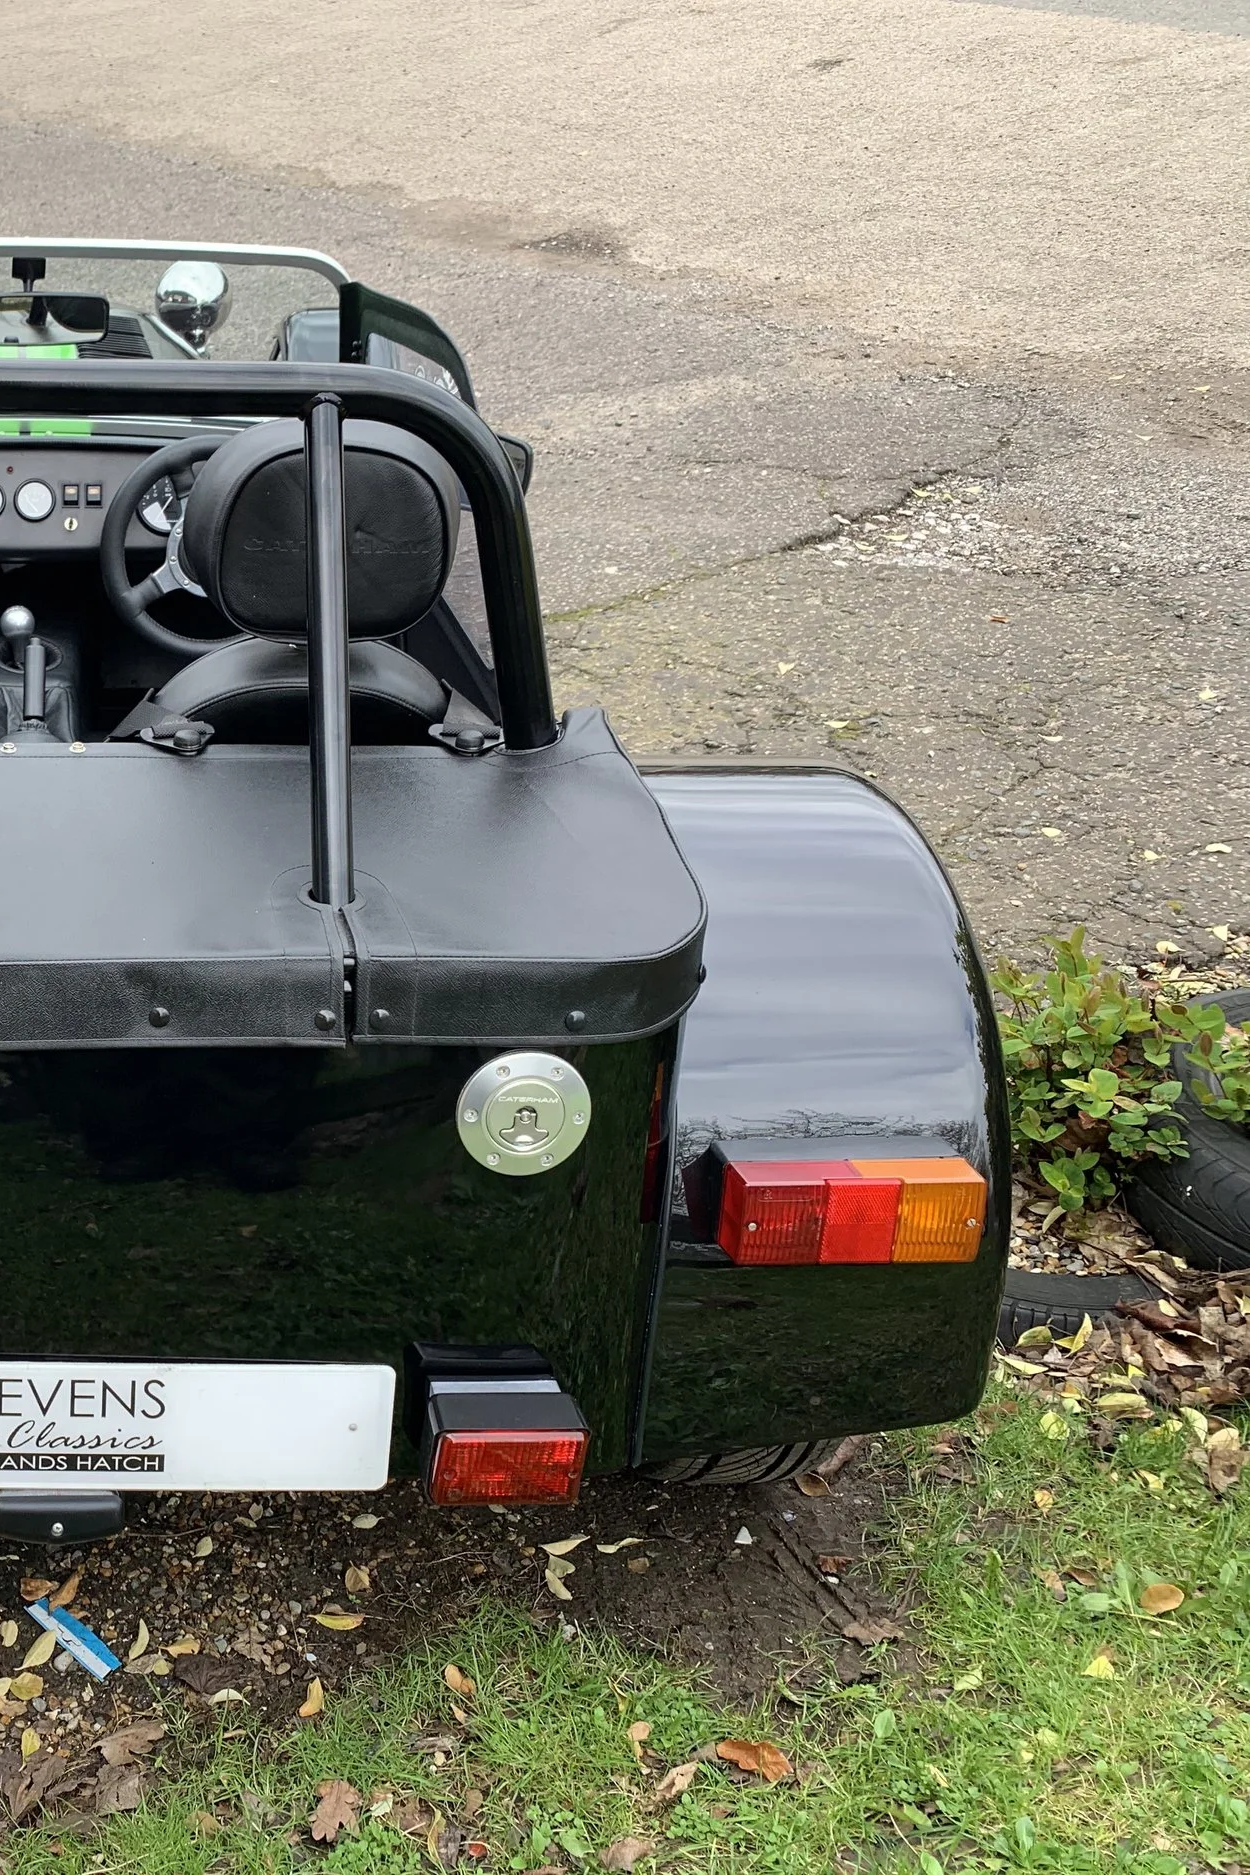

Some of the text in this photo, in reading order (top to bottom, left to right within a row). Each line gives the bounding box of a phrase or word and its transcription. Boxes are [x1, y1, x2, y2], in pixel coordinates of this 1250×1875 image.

[498, 1095, 560, 1104] CATERHAM
[6, 1419, 163, 1450] Classics
[76, 1455, 159, 1471] HATCH
